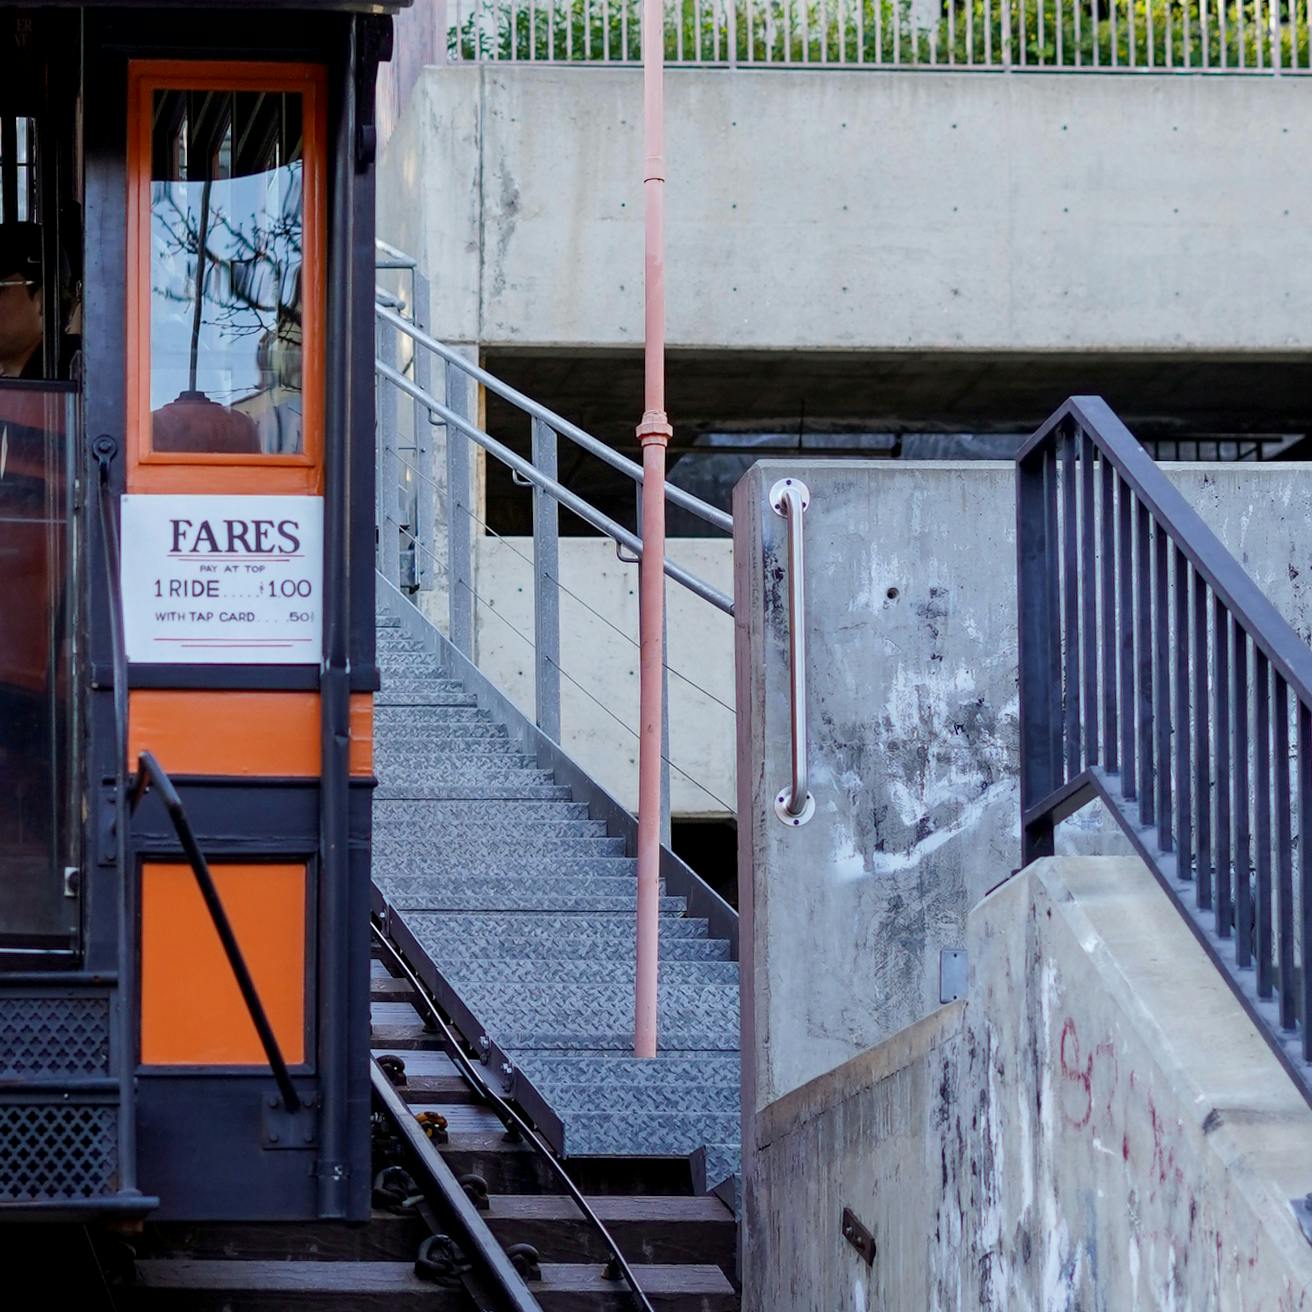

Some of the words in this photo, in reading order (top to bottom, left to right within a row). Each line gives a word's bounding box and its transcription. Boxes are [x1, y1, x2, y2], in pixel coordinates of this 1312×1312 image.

[169, 519, 301, 554] FARES
[199, 565, 218, 573] PAY
[224, 565, 240, 573] AT
[244, 565, 266, 573] TOP
[154, 579, 163, 597] 1
[169, 579, 220, 598] RIDE
[155, 611, 186, 622] WITH
[190, 611, 214, 622] TAP
[219, 611, 255, 622] CARD
